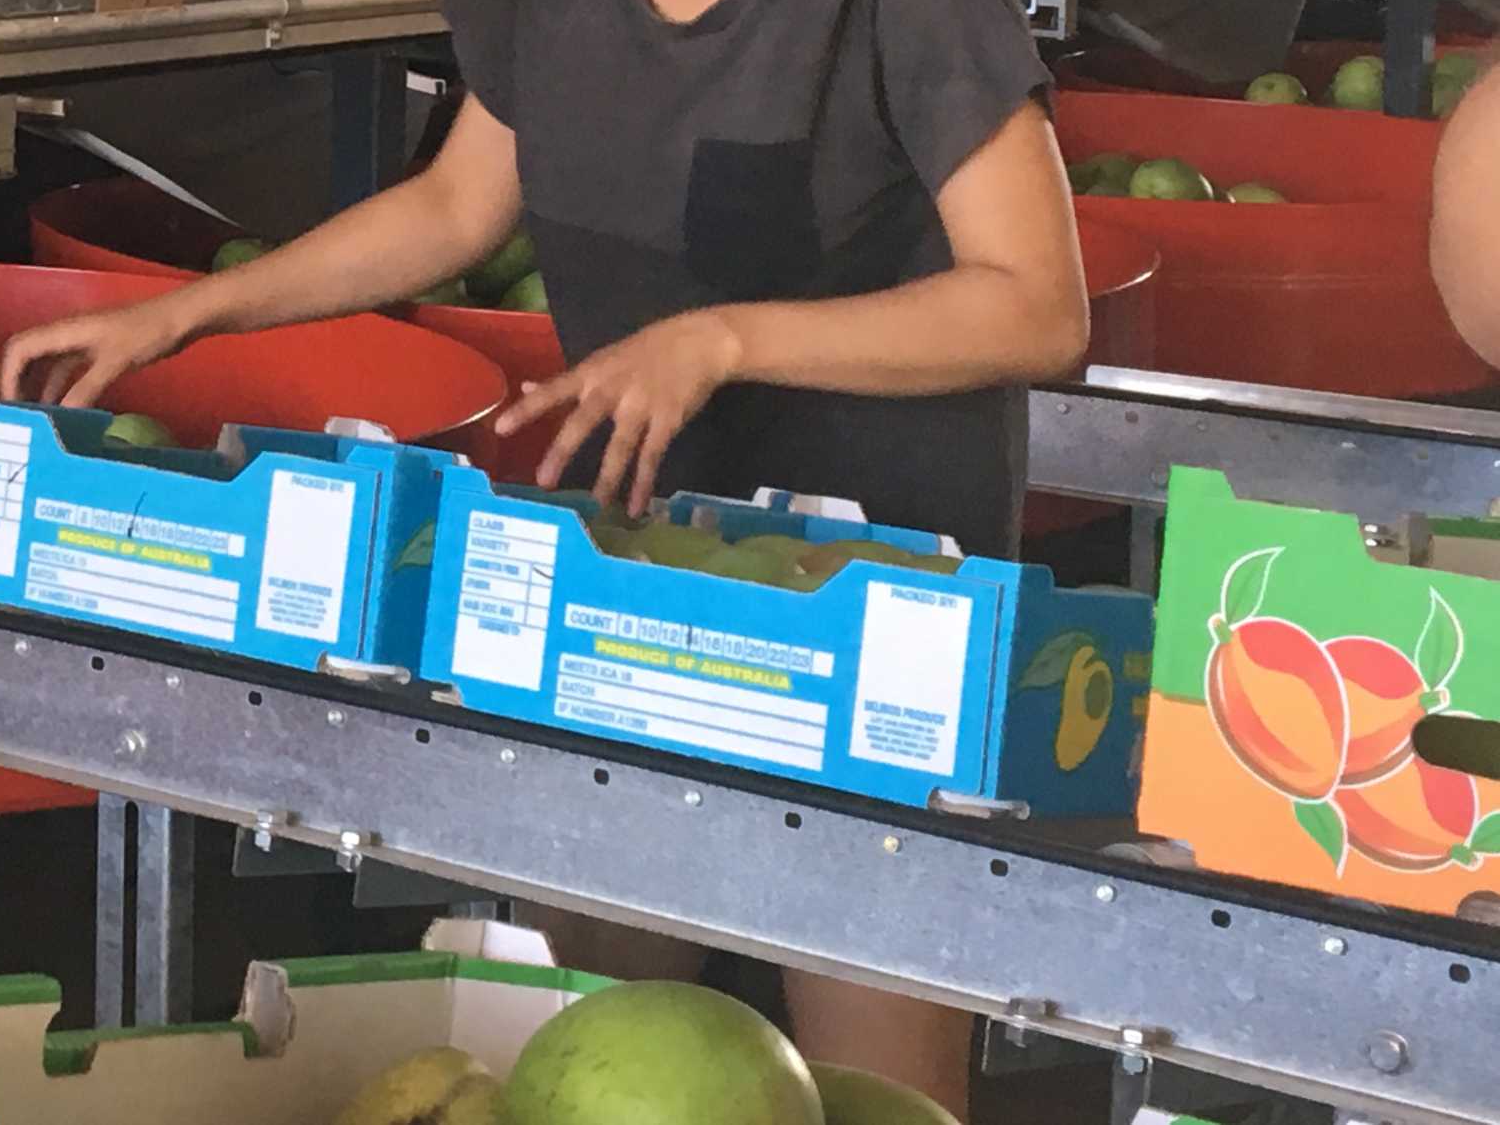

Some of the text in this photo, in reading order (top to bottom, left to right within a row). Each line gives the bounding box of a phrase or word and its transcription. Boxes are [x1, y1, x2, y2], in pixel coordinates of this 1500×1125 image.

[39, 505, 72, 520] COUNT
[473, 516, 505, 531] CLASS
[58, 528, 211, 572] PRODUCE OF AUSTRALIA
[470, 535, 510, 552] VARIETY
[890, 586, 936, 606] PACKED
[570, 609, 614, 630] COUNT
[623, 619, 632, 634] 8
[641, 623, 657, 638] 10
[663, 628, 679, 642] 12
[705, 637, 720, 650] 16
[727, 641, 742, 656] 18
[748, 643, 765, 659] 20
[771, 648, 786, 663] 22
[594, 637, 791, 691] PRODUCE OF AUSTRALIA
[562, 680, 595, 696] BATCH
